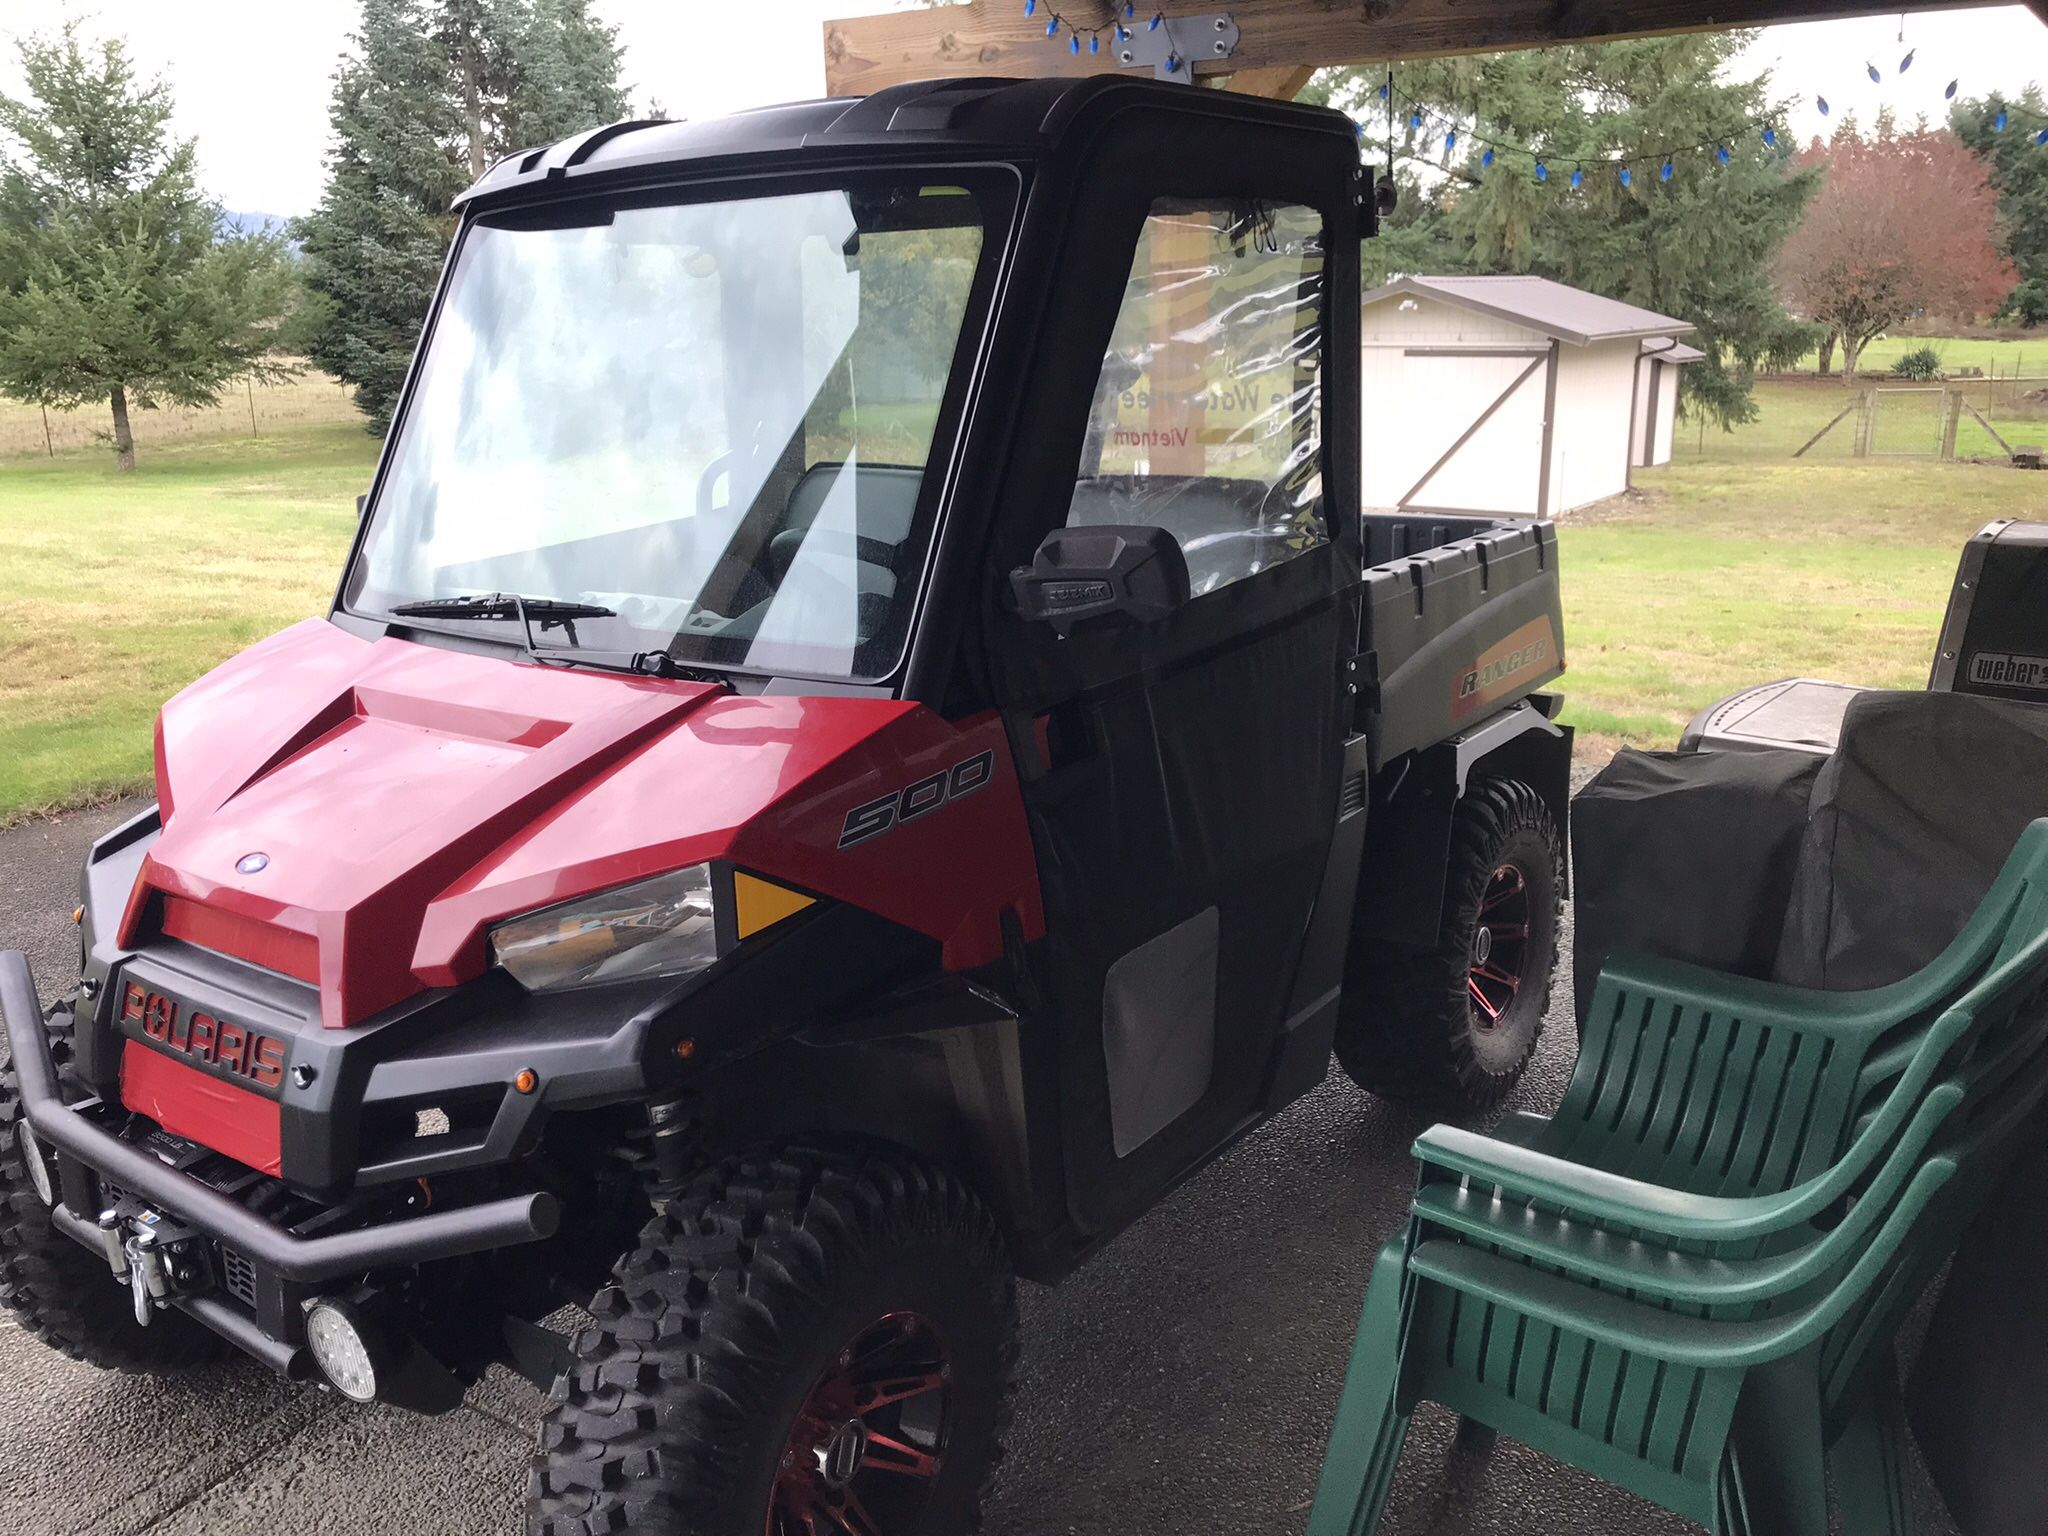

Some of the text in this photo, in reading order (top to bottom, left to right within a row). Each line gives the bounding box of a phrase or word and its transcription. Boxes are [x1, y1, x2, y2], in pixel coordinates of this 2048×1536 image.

[1459, 639, 1548, 698] RANGER
[1976, 654, 2040, 684] weber
[837, 749, 994, 850] 500
[120, 981, 286, 1088] POLARIS
